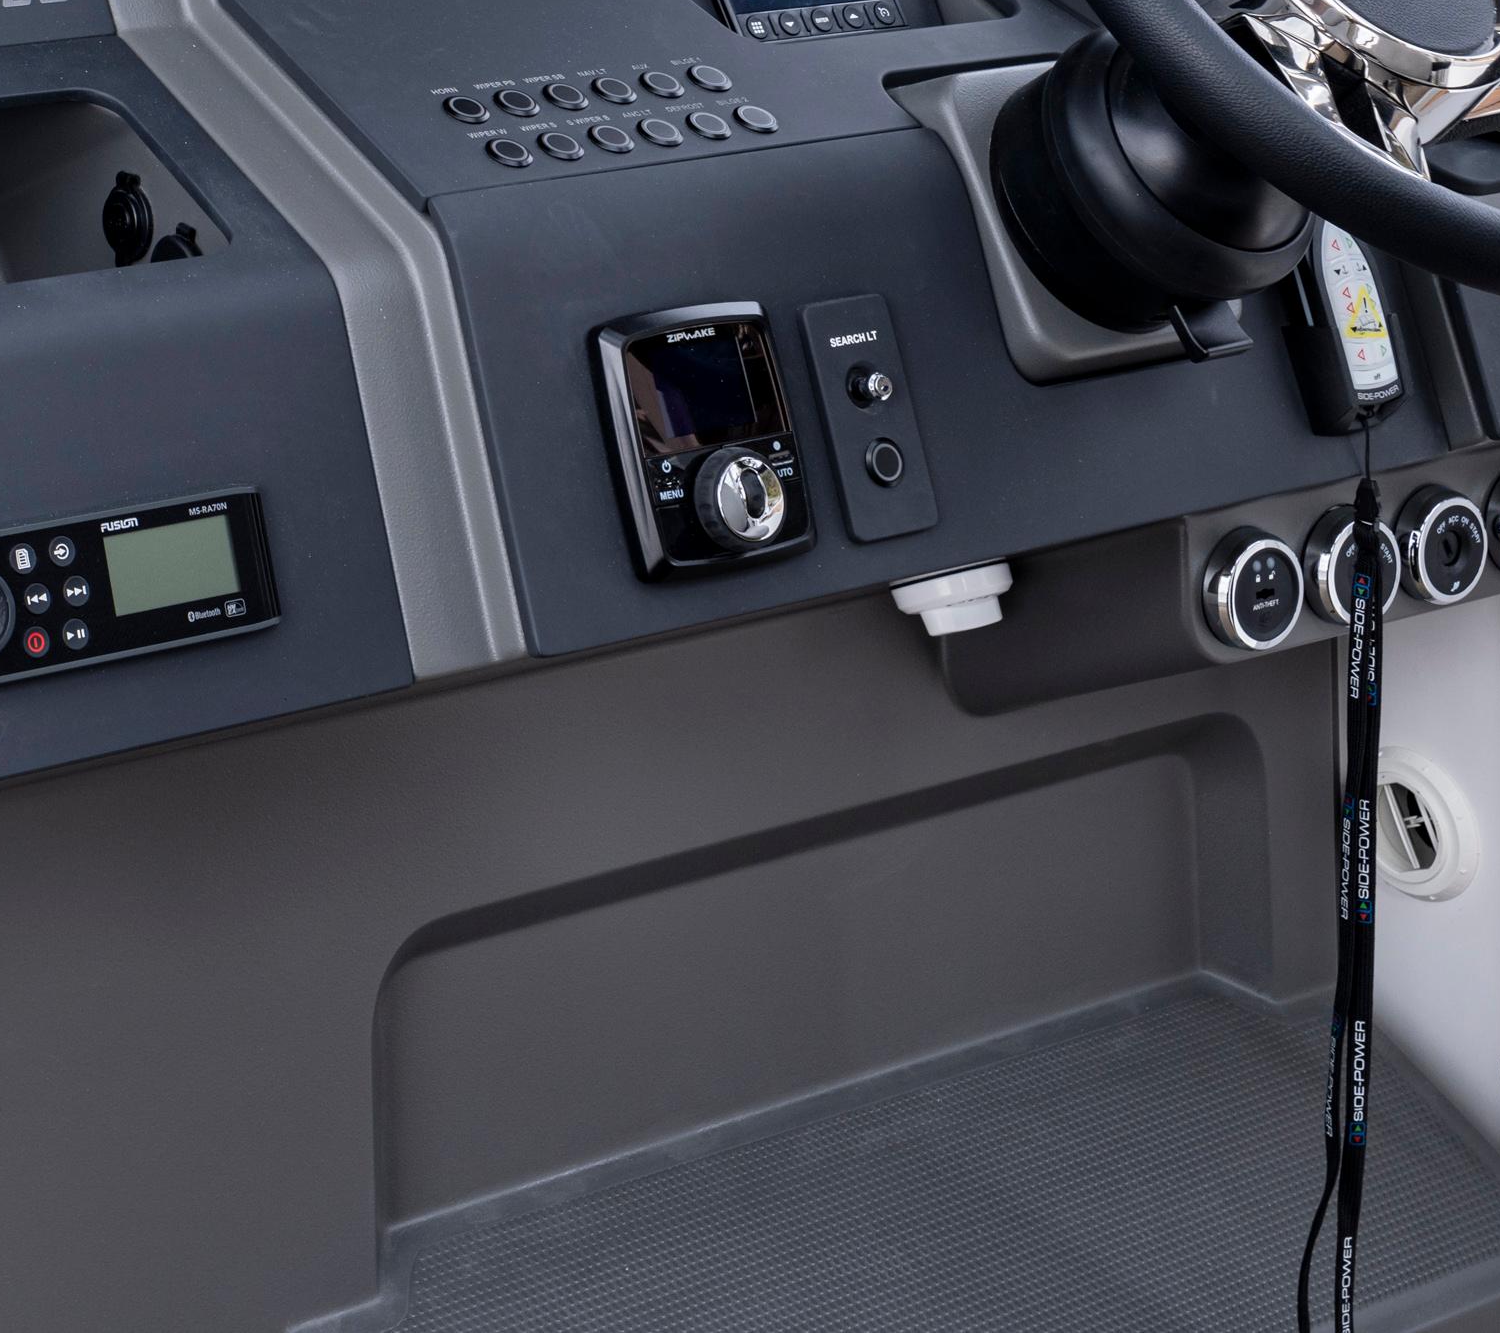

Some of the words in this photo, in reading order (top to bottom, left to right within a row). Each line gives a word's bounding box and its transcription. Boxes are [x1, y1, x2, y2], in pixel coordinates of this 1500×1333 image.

[522, 75, 551, 84] WIPER
[577, 70, 595, 78] NAV
[430, 87, 459, 96] HORN
[473, 81, 502, 90] WIPER
[574, 116, 602, 126] WIPER
[520, 123, 549, 132] WIPER
[467, 130, 497, 139] WIPER
[829, 333, 867, 348] SEARCH
[867, 330, 878, 342] LT
[1357, 384, 1400, 401] SIDE-POWER
[777, 466, 794, 478] UTO
[659, 489, 684, 501] MENU
[188, 502, 228, 516] MS-RA70N
[100, 517, 139, 533] FUSION
[195, 607, 222, 620] Bluetooth
[1350, 598, 1366, 699] SIDE-POWER
[1358, 799, 1370, 900] SIDE-POWER
[1341, 818, 1351, 921] SIDE-POWER
[1354, 1020, 1366, 1122] SIDE-POWER
